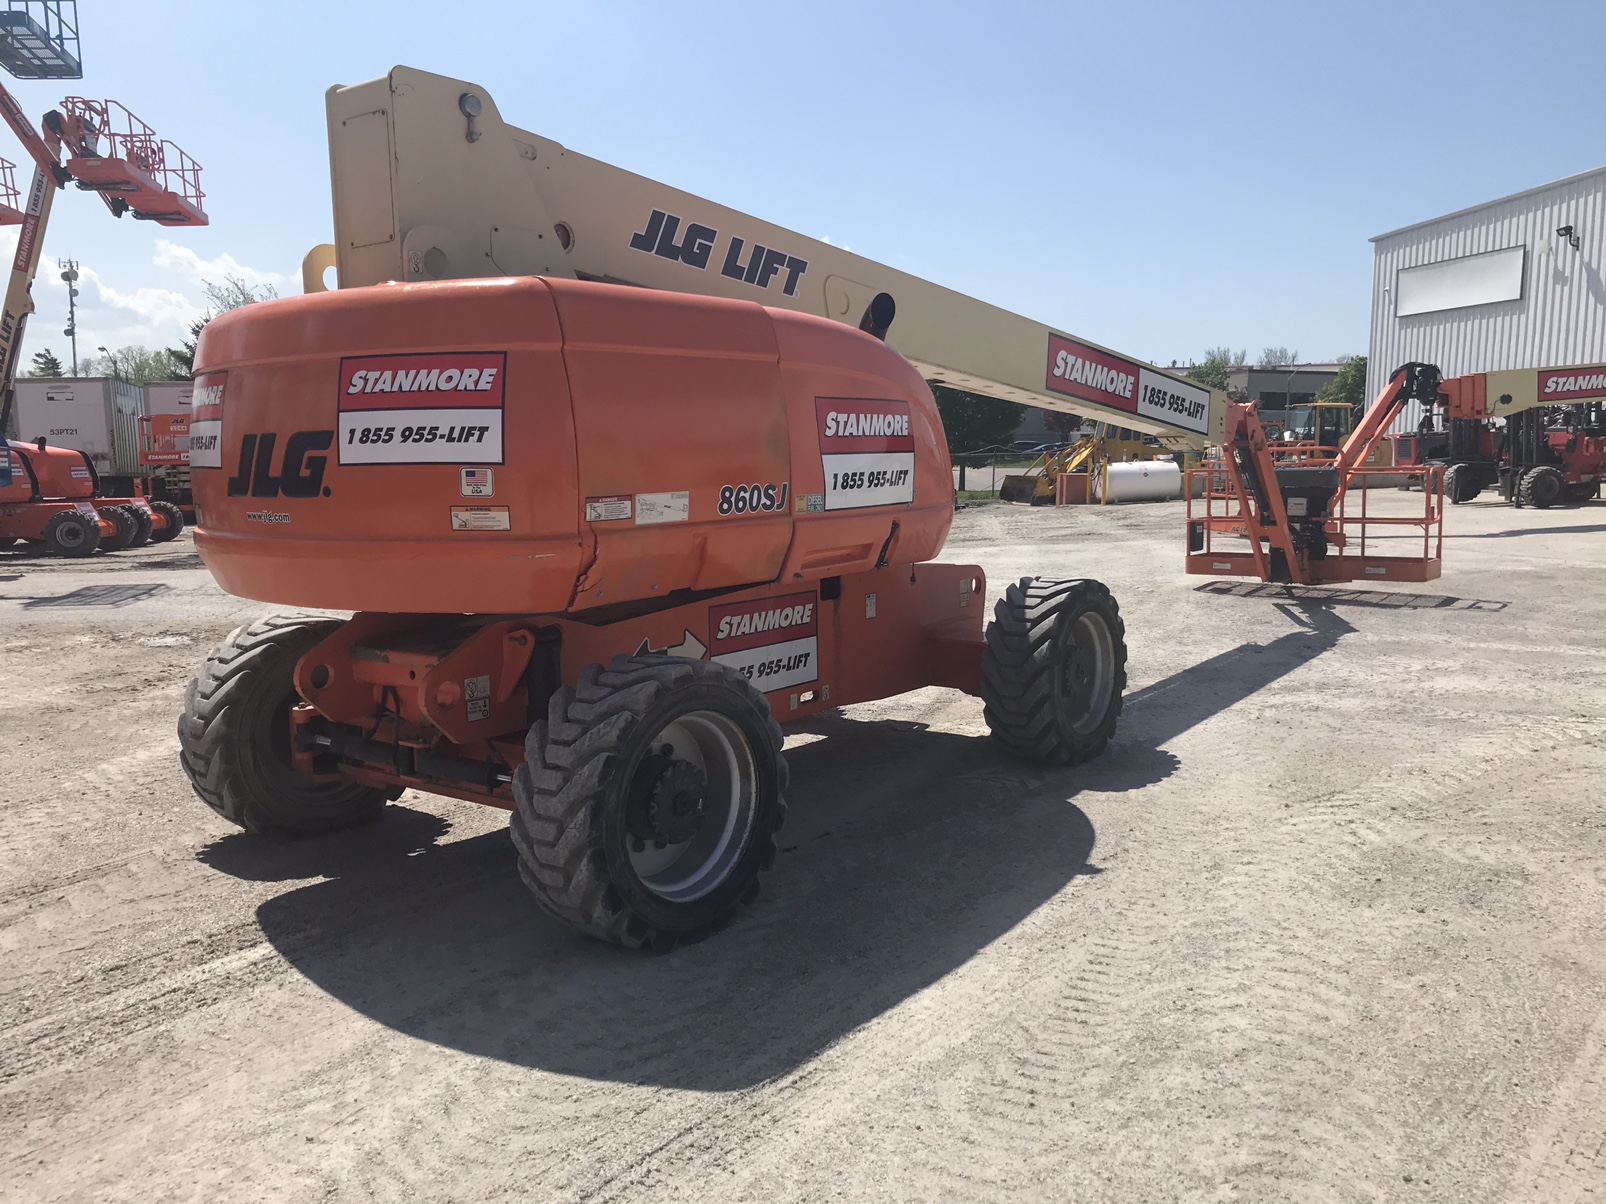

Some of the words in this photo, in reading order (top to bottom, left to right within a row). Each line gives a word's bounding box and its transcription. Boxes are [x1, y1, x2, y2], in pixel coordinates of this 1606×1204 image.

[18, 217, 36, 268] STANMORE
[628, 208, 719, 271] JLG
[720, 235, 809, 297] LIFT
[0, 309, 15, 344] LIFT
[347, 368, 498, 396] STANMORE
[1052, 350, 1134, 399] STANMORE
[1142, 385, 1148, 402] 1
[1148, 387, 1168, 409] 855
[1168, 394, 1206, 420] 955-LIFT
[348, 428, 356, 444] 1
[358, 427, 396, 444] 855
[400, 426, 490, 444] 955-LIFT
[825, 411, 909, 438] STANMORE
[832, 473, 838, 490] 1
[841, 472, 865, 490] 855
[867, 470, 909, 488] 955-LIFT
[718, 482, 788, 516] 860SJ
[808, 496, 822, 505] DIESEL
[246, 510, 290, 524] www.jlg.com
[716, 603, 814, 640] STANMORE
[739, 665, 754, 680] 55
[757, 652, 811, 678] 955-LIFT
